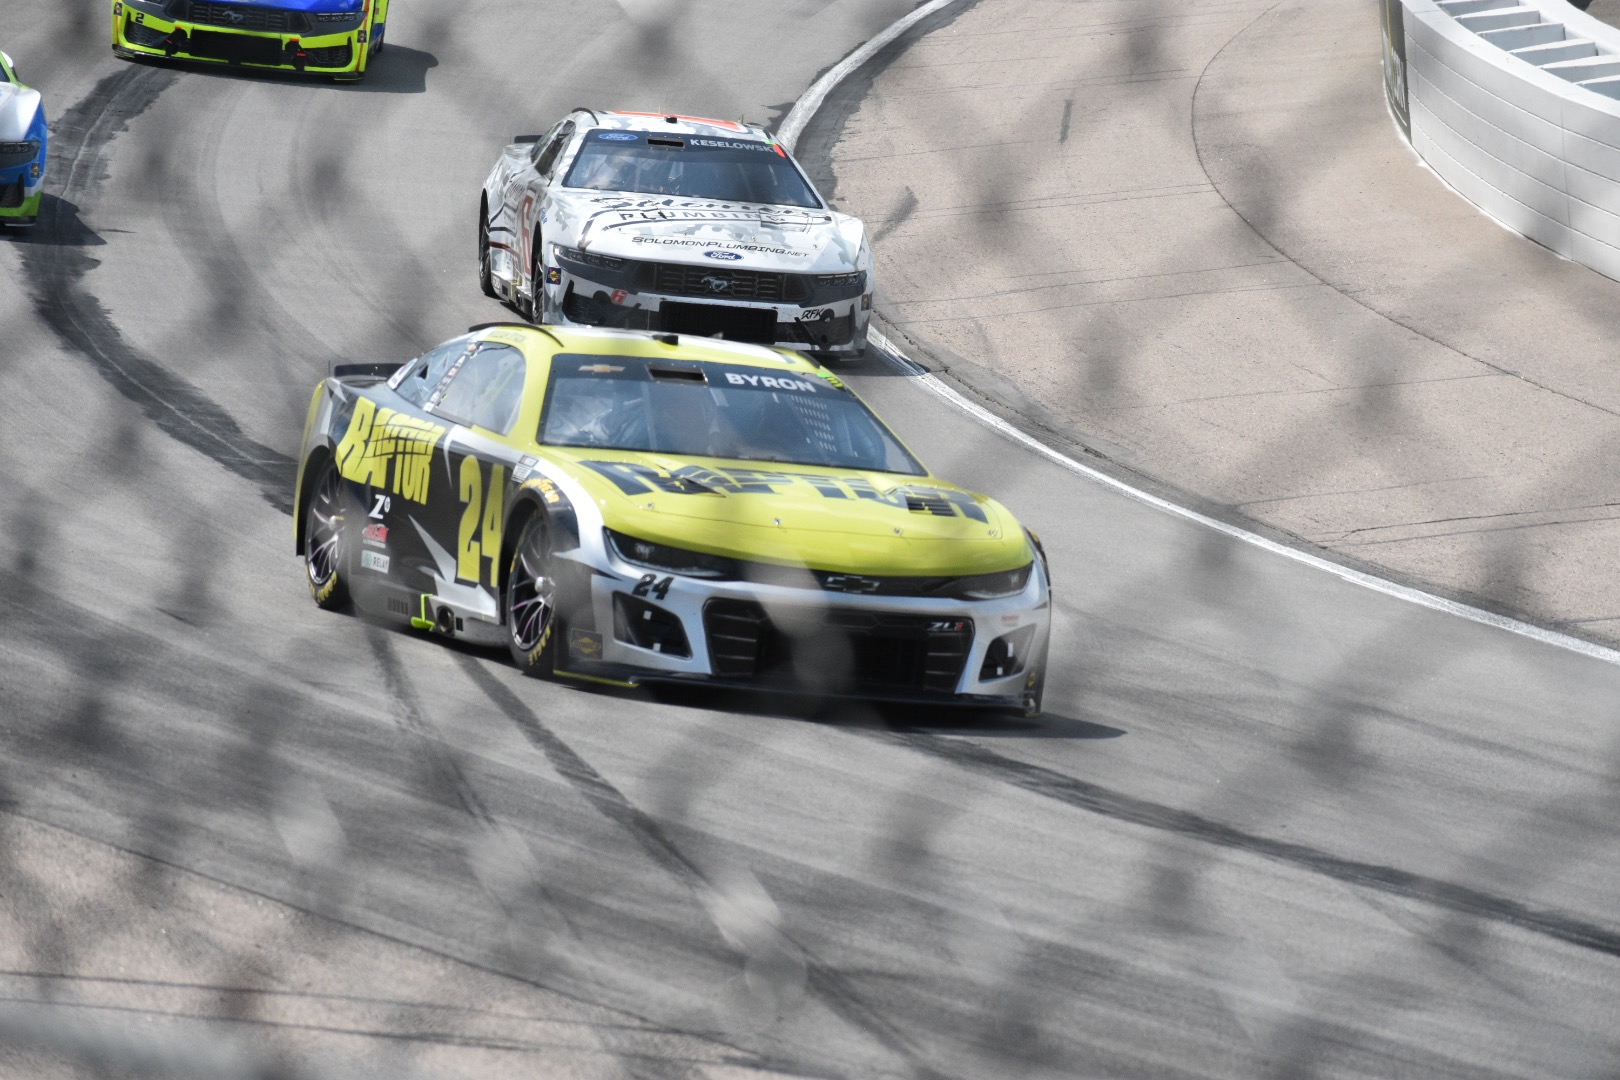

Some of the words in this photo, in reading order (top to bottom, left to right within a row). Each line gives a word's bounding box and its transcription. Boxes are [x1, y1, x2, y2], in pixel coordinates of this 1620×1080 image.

[135, 12, 145, 24] 2
[801, 308, 824, 320] RFK
[725, 373, 816, 393] BYRON
[457, 454, 504, 588] 24
[632, 573, 674, 600] 24
